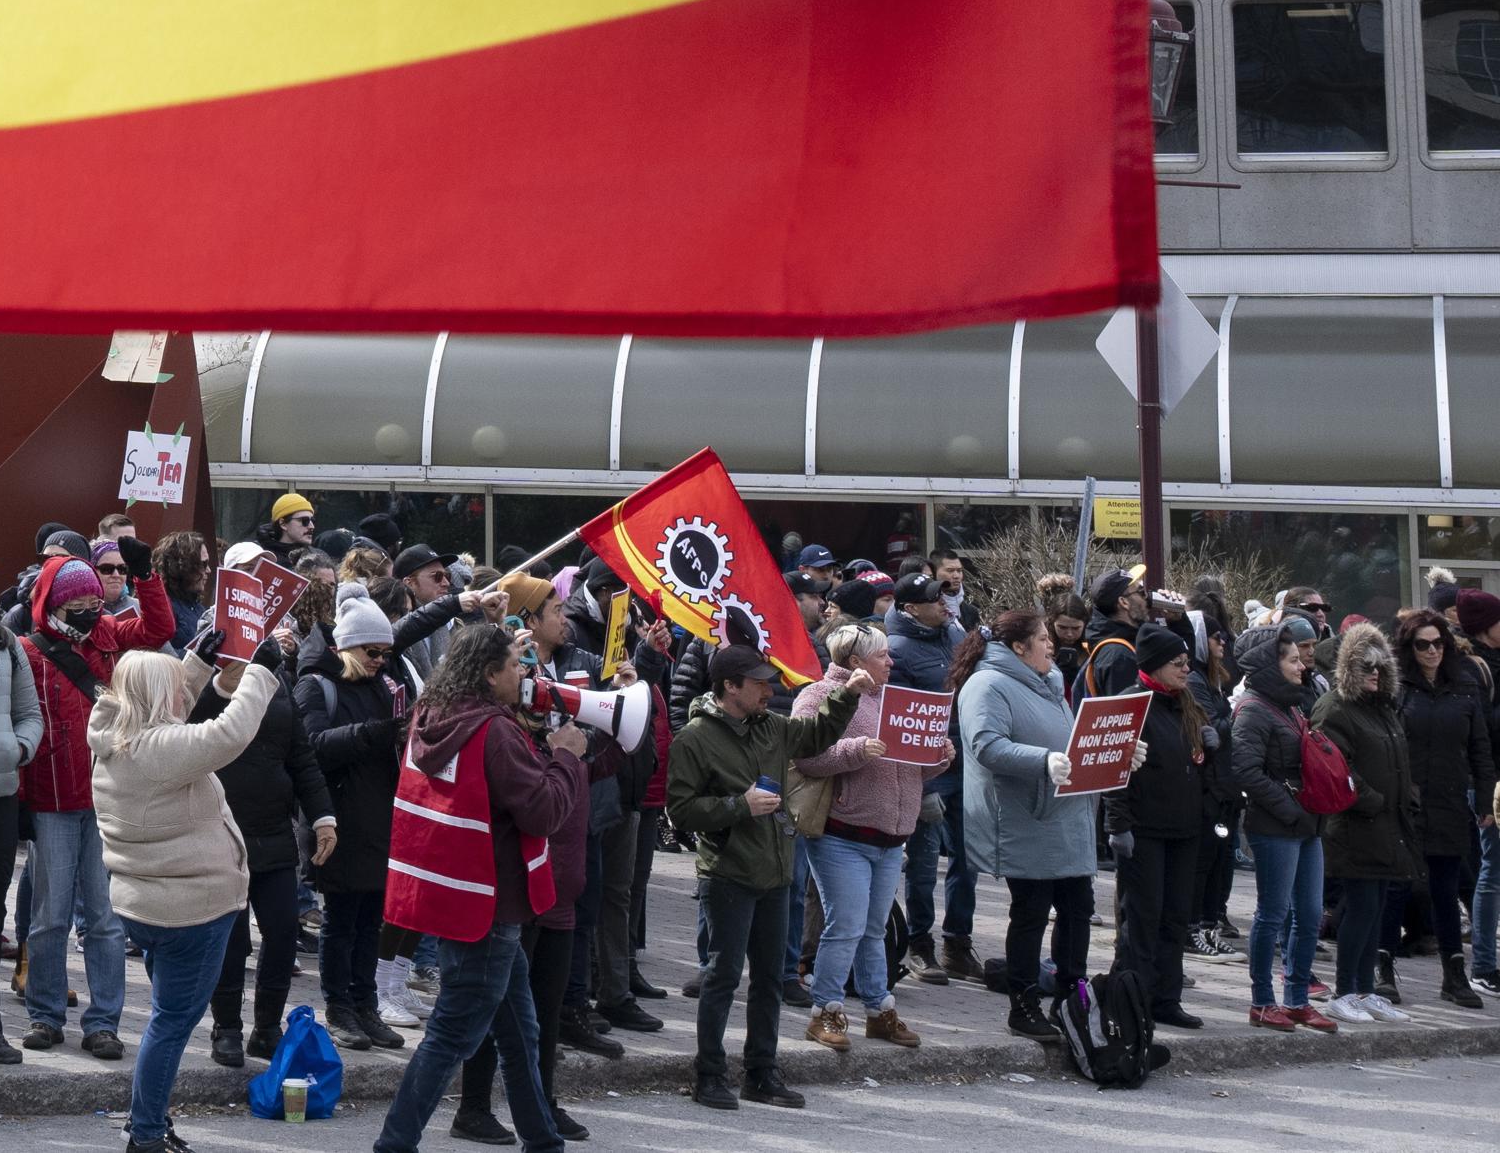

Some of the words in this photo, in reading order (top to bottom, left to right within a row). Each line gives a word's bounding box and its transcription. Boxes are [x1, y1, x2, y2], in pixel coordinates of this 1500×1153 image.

[1109, 520, 1140, 528] Caution!
[676, 537, 708, 586] AFPC
[225, 587, 229, 600] I
[241, 625, 257, 644] TEAM
[599, 701, 614, 710] PYL
[889, 714, 926, 731] MON
[1092, 713, 1134, 729] J'APPUIE
[901, 732, 921, 746] DE
[924, 734, 945, 748] NÉG
[1078, 734, 1102, 749] MON
[1102, 730, 1135, 746] ÉQUIPE
[1081, 753, 1095, 766] DE
[1096, 748, 1123, 765] NÉGO
